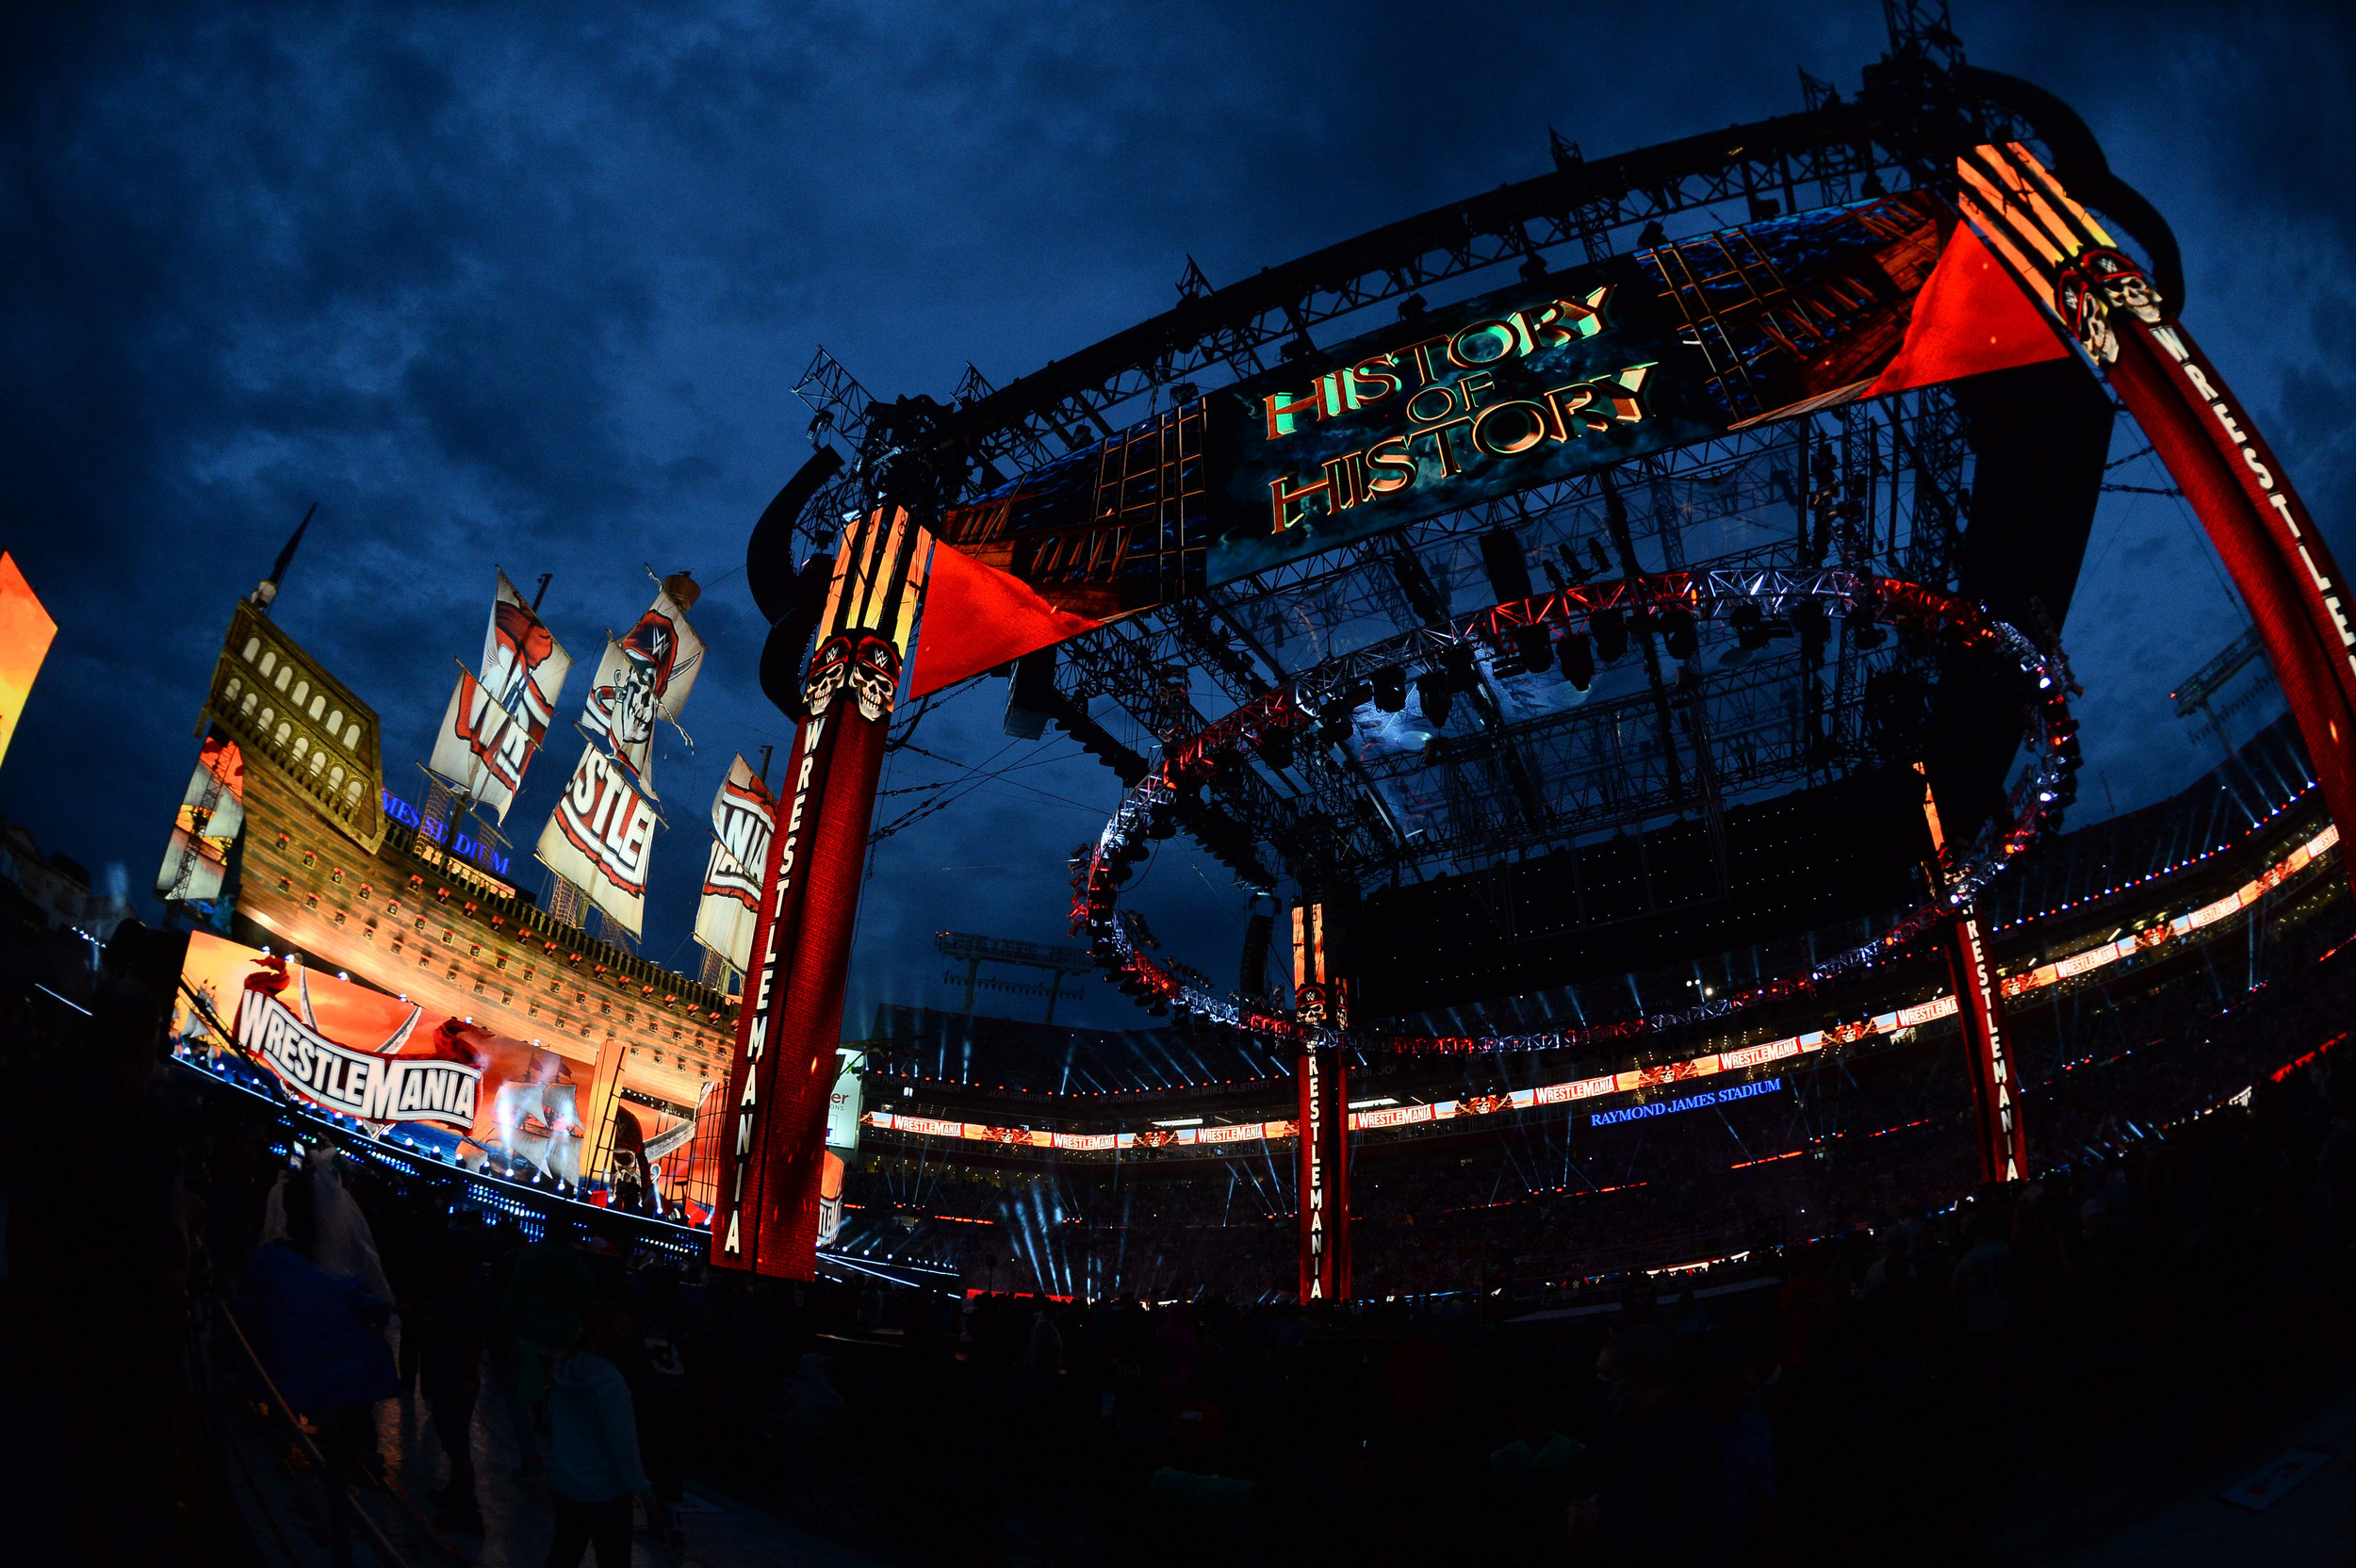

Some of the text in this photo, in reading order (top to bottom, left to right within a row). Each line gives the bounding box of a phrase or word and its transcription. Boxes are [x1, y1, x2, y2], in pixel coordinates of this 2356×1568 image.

[1263, 284, 1617, 440] HISTORY
[1407, 371, 1496, 424] OF
[1268, 362, 1659, 534] HISTORY
[2149, 325, 2356, 678] WRESTLE
[422, 816, 511, 876] STDIUM
[725, 716, 826, 1253] WRESTLEMANIA
[238, 989, 480, 1127] WRESTLEMANIA
[1720, 1038, 1798, 1070] WRESTLEMANIA
[1535, 1077, 1614, 1103] WRESTLEMANIA
[1591, 1078, 1781, 1127] RAYMOND JAMES STADIUM
[894, 1115, 961, 1136] WRESTLEMANIA
[1054, 1133, 1115, 1150] WRESTLEMANIA
[1198, 1124, 1264, 1144] WRESTLEMANIA
[1358, 1104, 1432, 1128] WRESTLEMANIA
